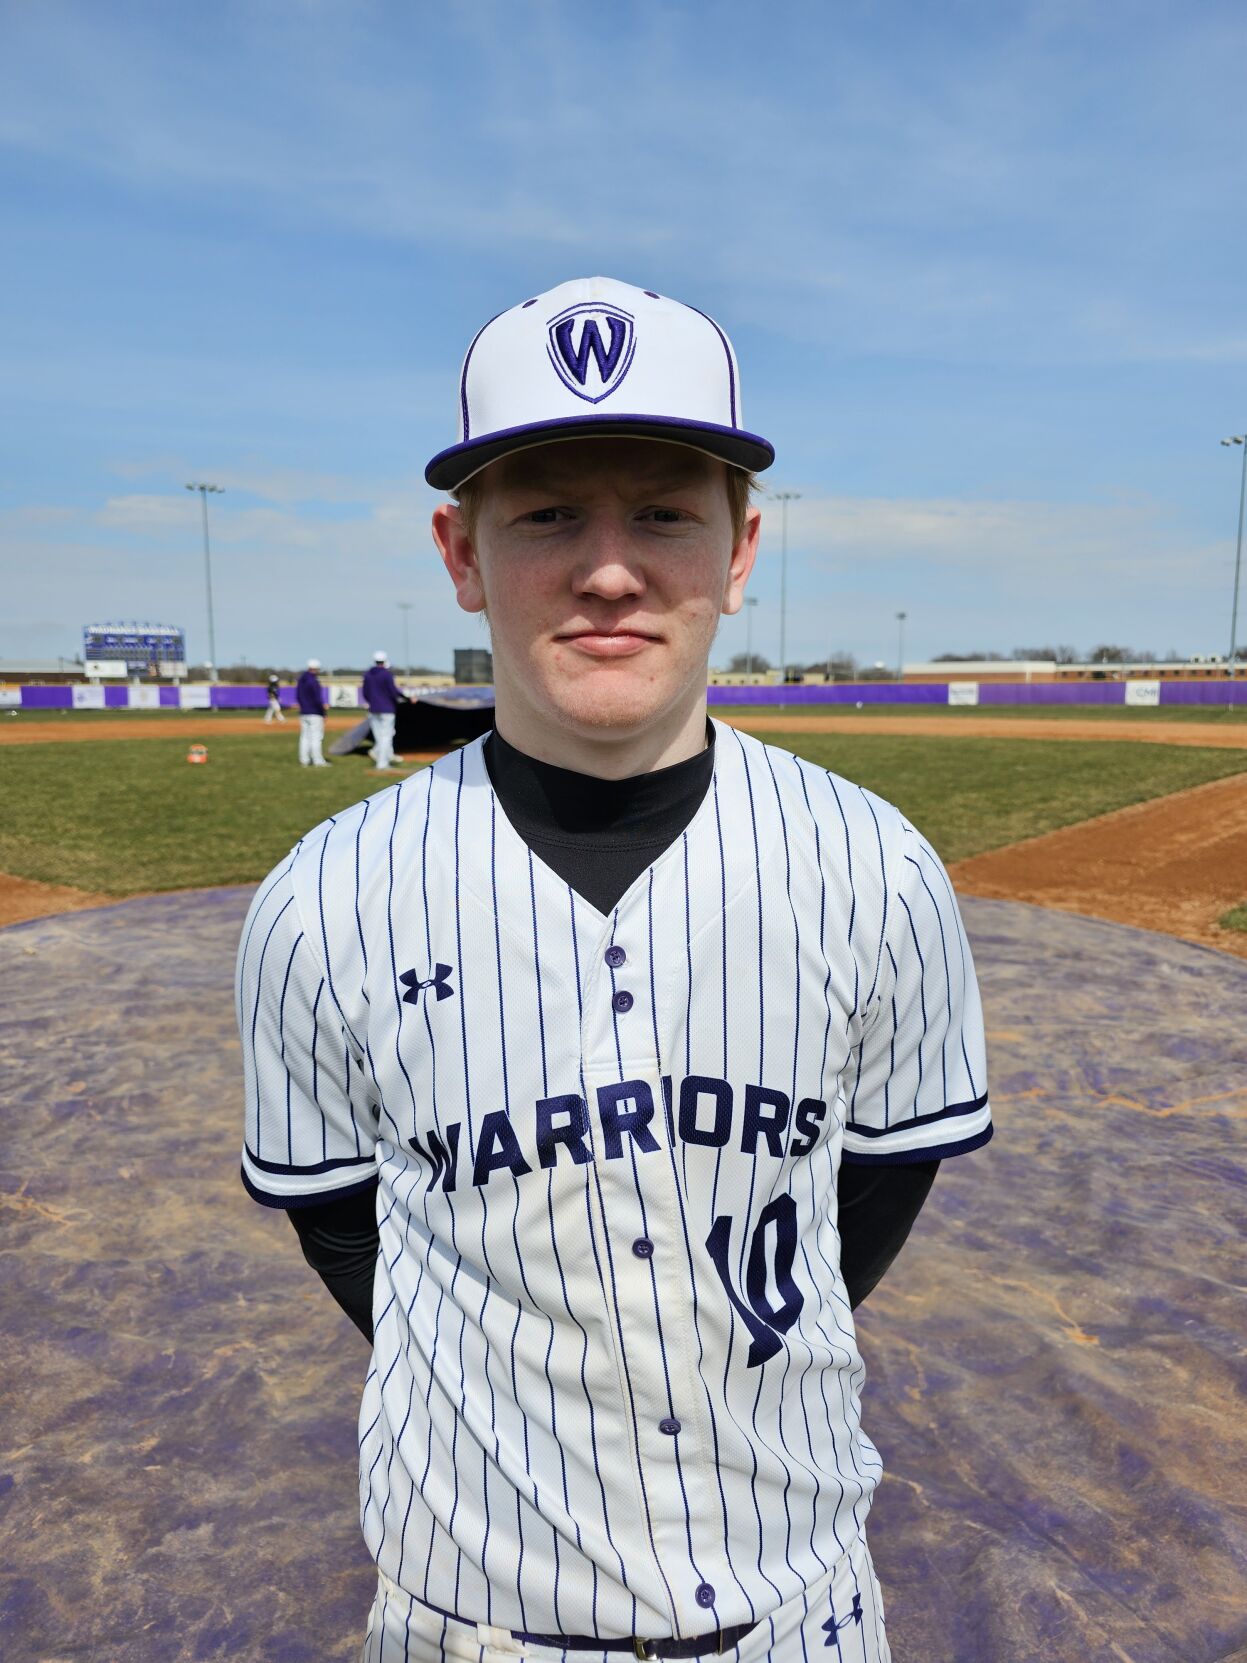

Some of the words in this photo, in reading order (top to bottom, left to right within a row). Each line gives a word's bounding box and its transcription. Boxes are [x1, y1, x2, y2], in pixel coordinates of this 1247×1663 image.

[555, 316, 627, 386] W
[408, 1075, 827, 1192] WARRIORS
[705, 1192, 804, 1368] 10
